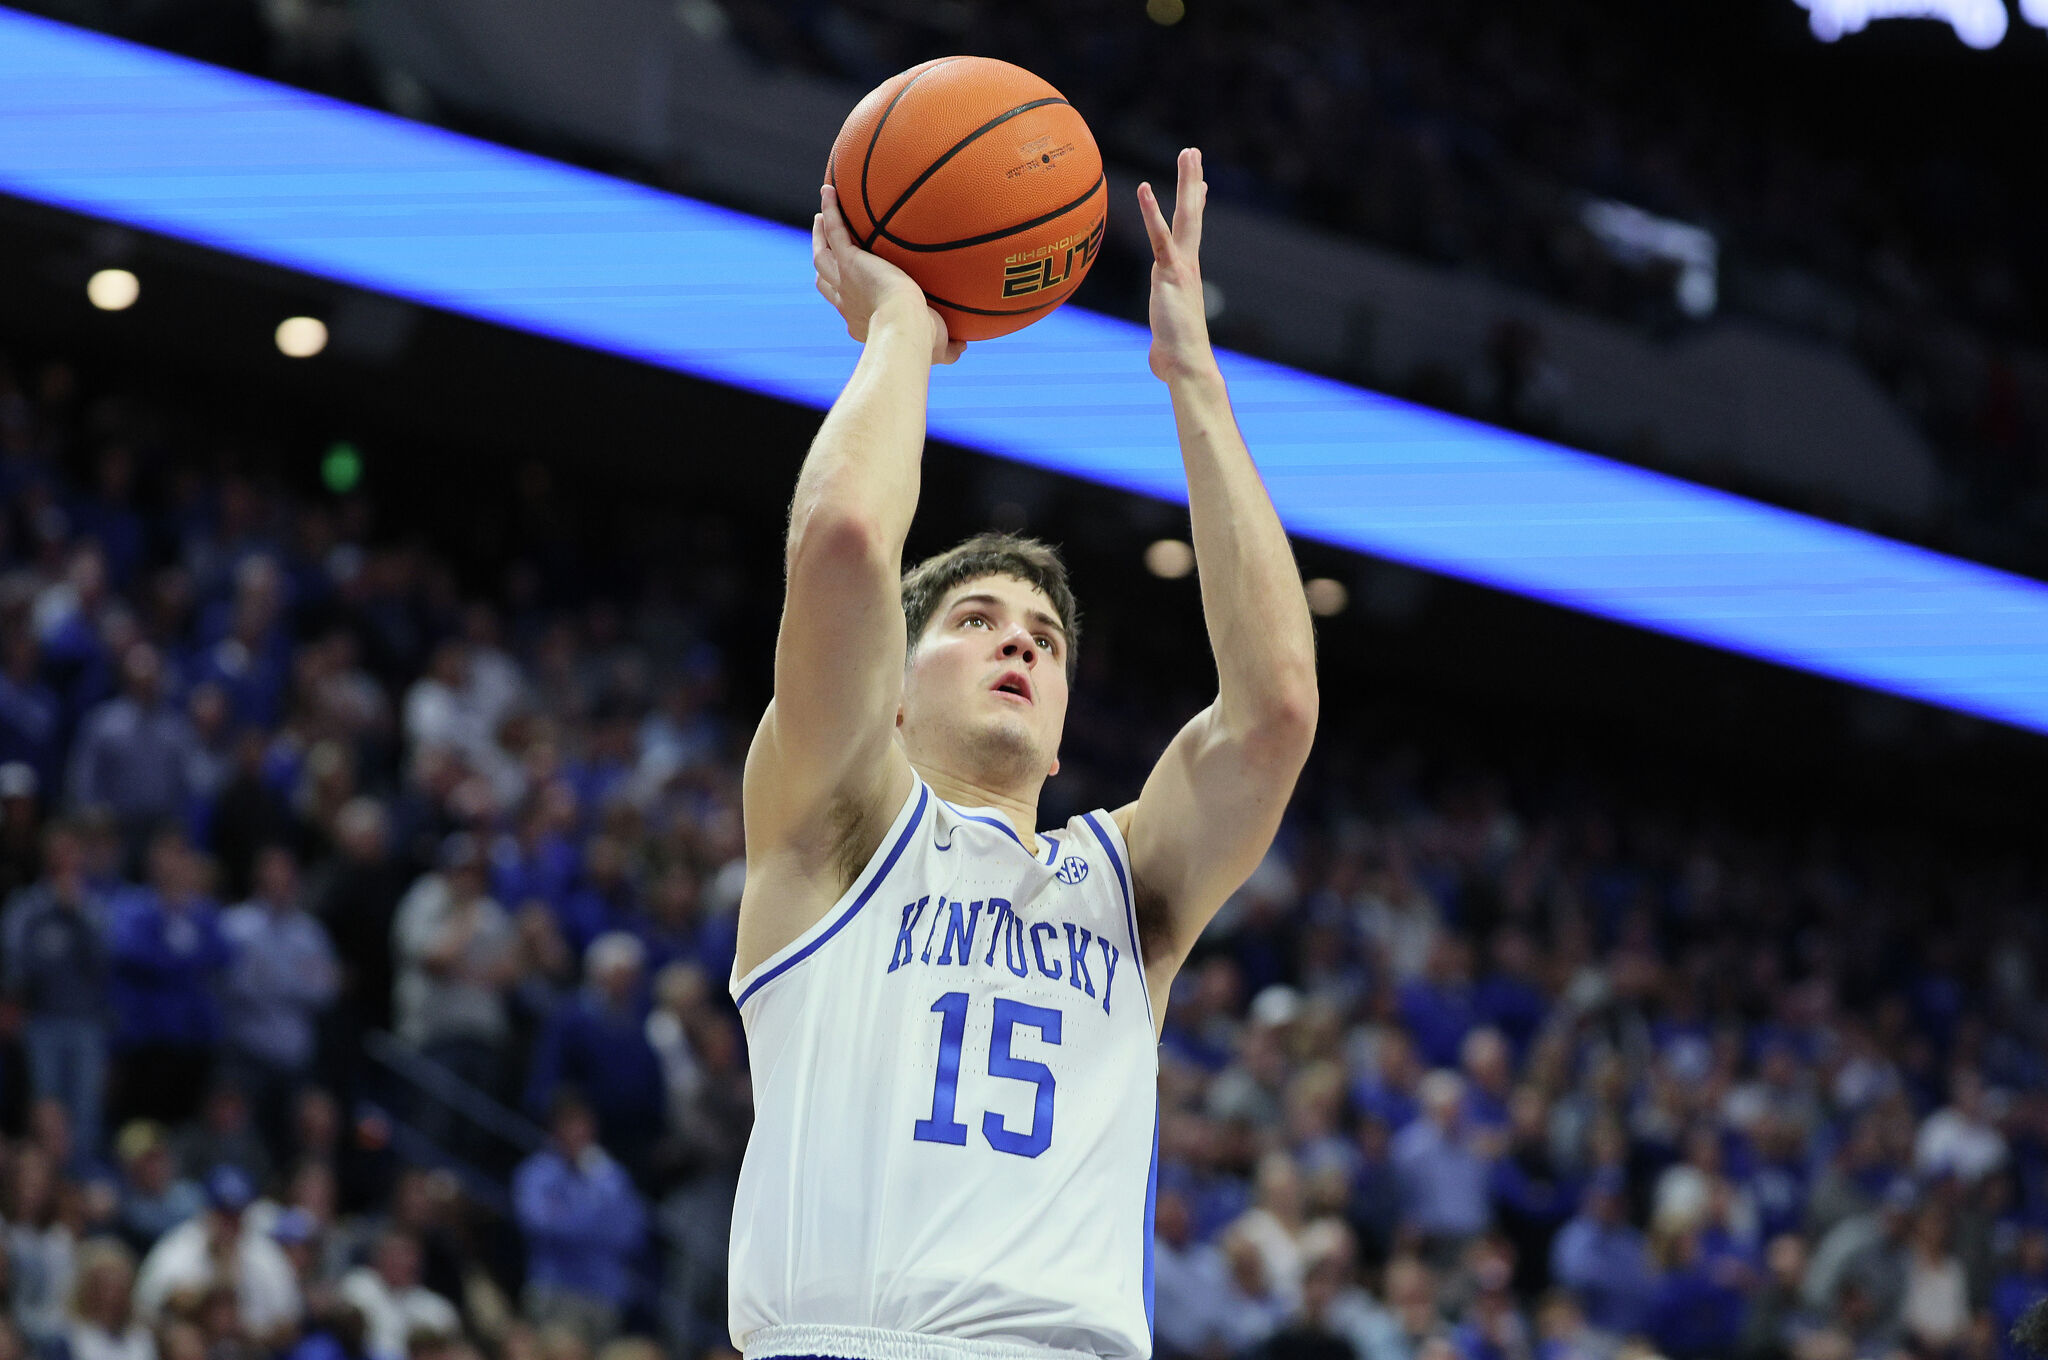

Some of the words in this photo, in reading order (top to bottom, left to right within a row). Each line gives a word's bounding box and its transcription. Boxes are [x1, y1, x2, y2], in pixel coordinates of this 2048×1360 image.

[1002, 215, 1104, 298] ELITE
[1005, 211, 1103, 263] PIONSHIP
[1056, 856, 1089, 885] SEC
[913, 991, 1063, 1159] 15
